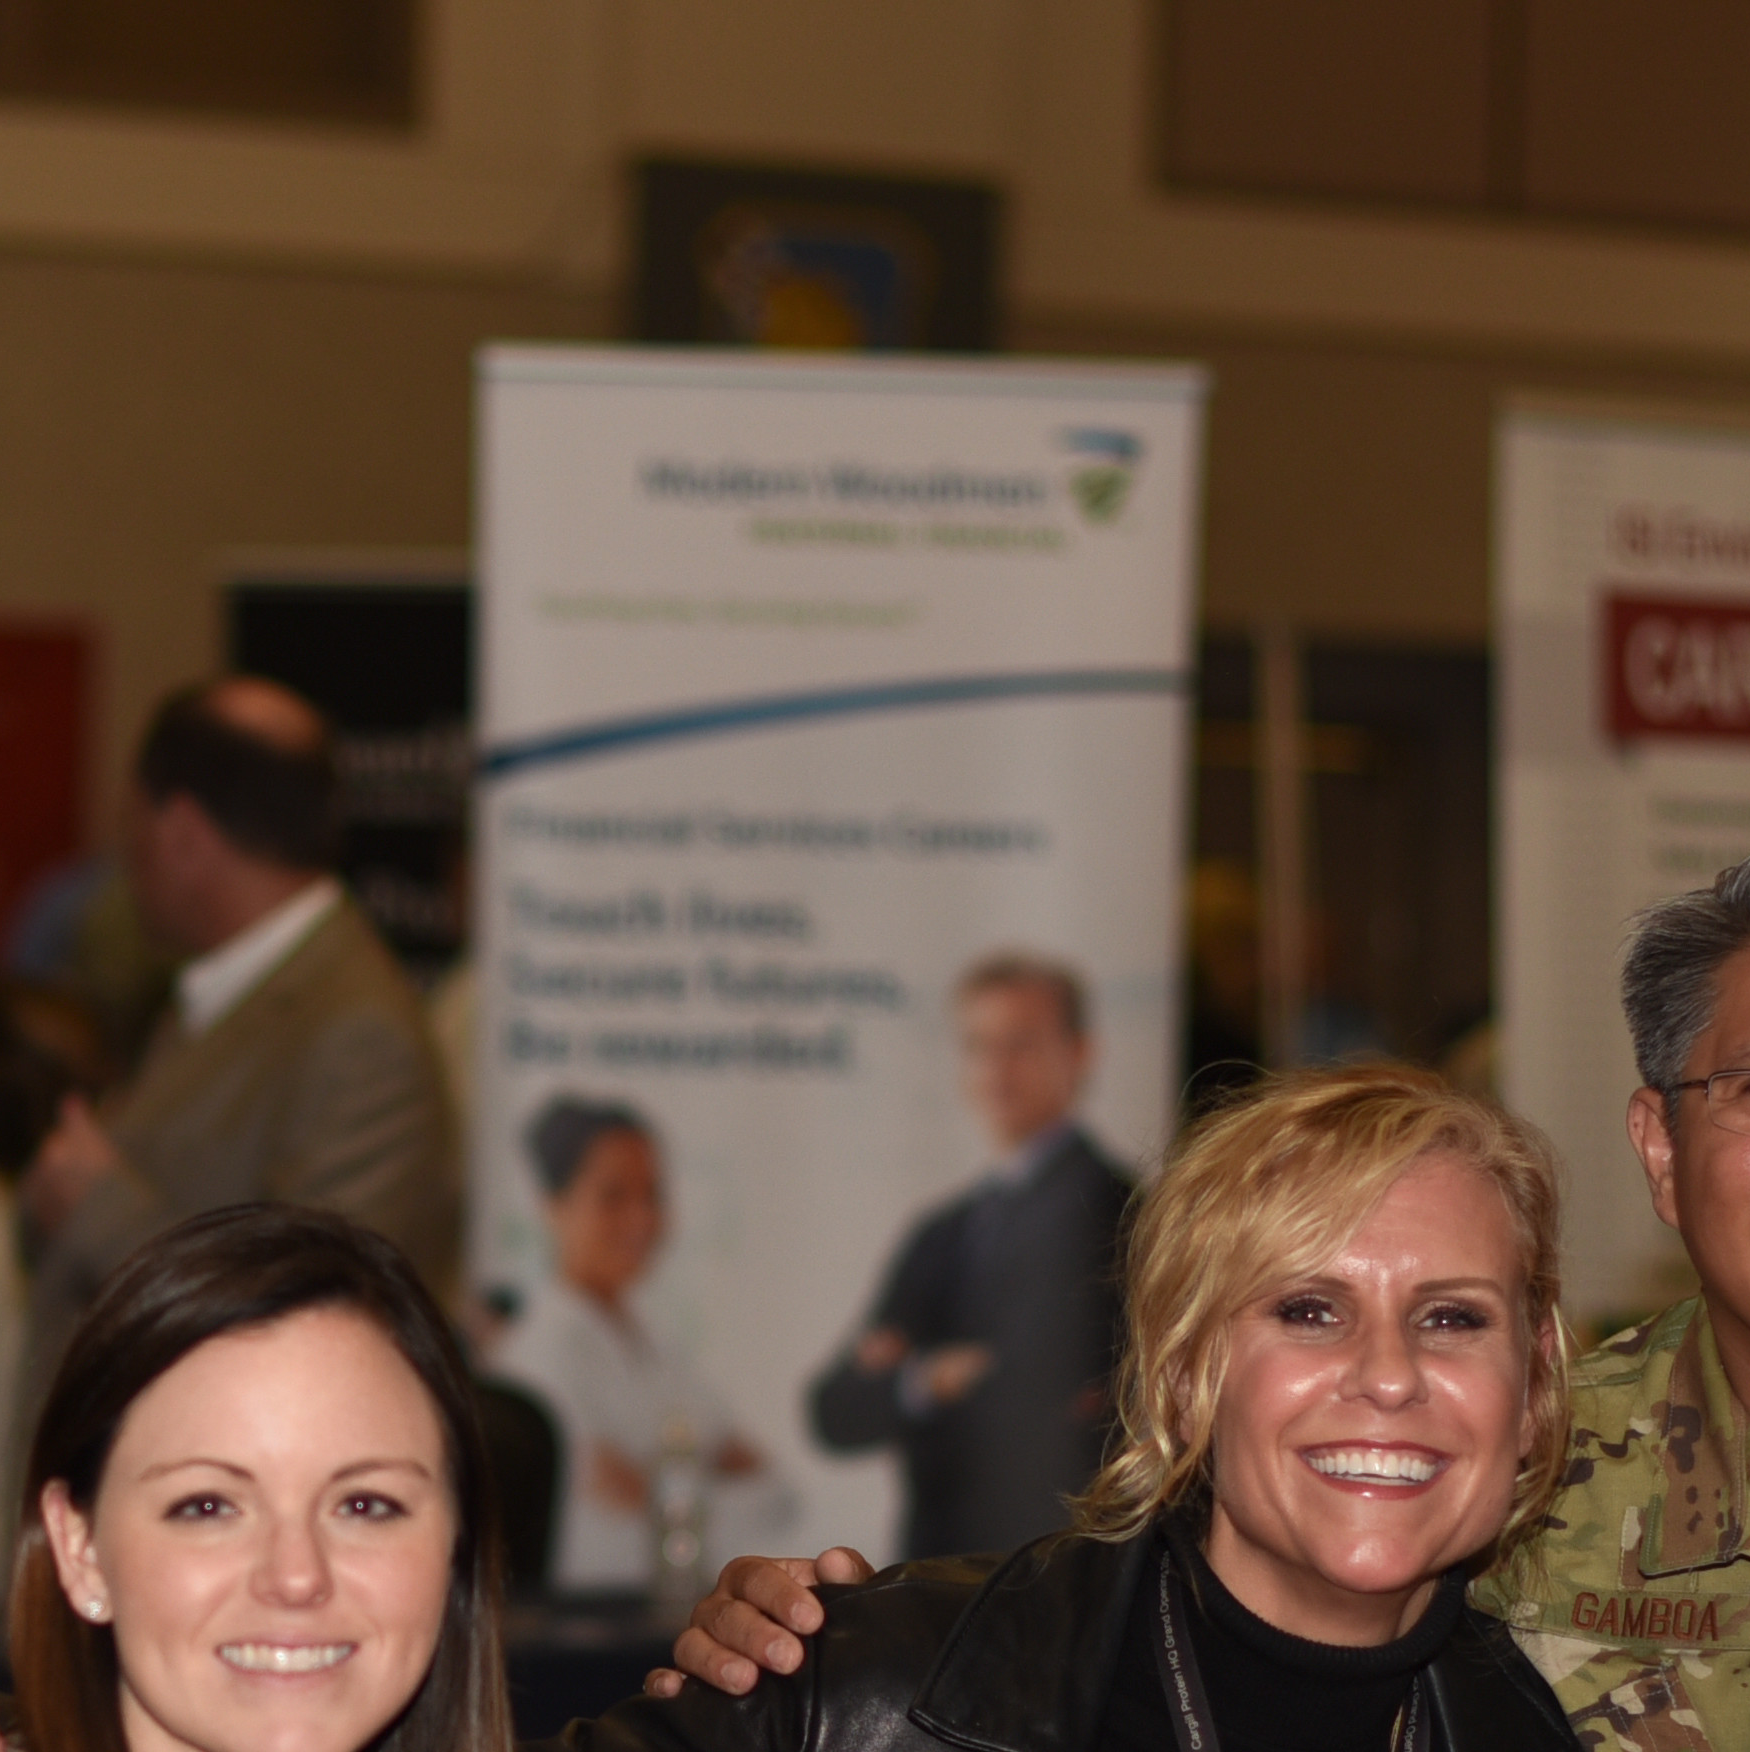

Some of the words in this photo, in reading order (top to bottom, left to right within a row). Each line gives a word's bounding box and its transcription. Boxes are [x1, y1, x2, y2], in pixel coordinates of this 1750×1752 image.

[1163, 1615, 1175, 1648] Grand
[1571, 1592, 1719, 1642] GAMBOA
[1170, 1648, 1179, 1670] HQ
[1176, 1670, 1192, 1712] Protein
[1183, 1715, 1202, 1750] Cargill
